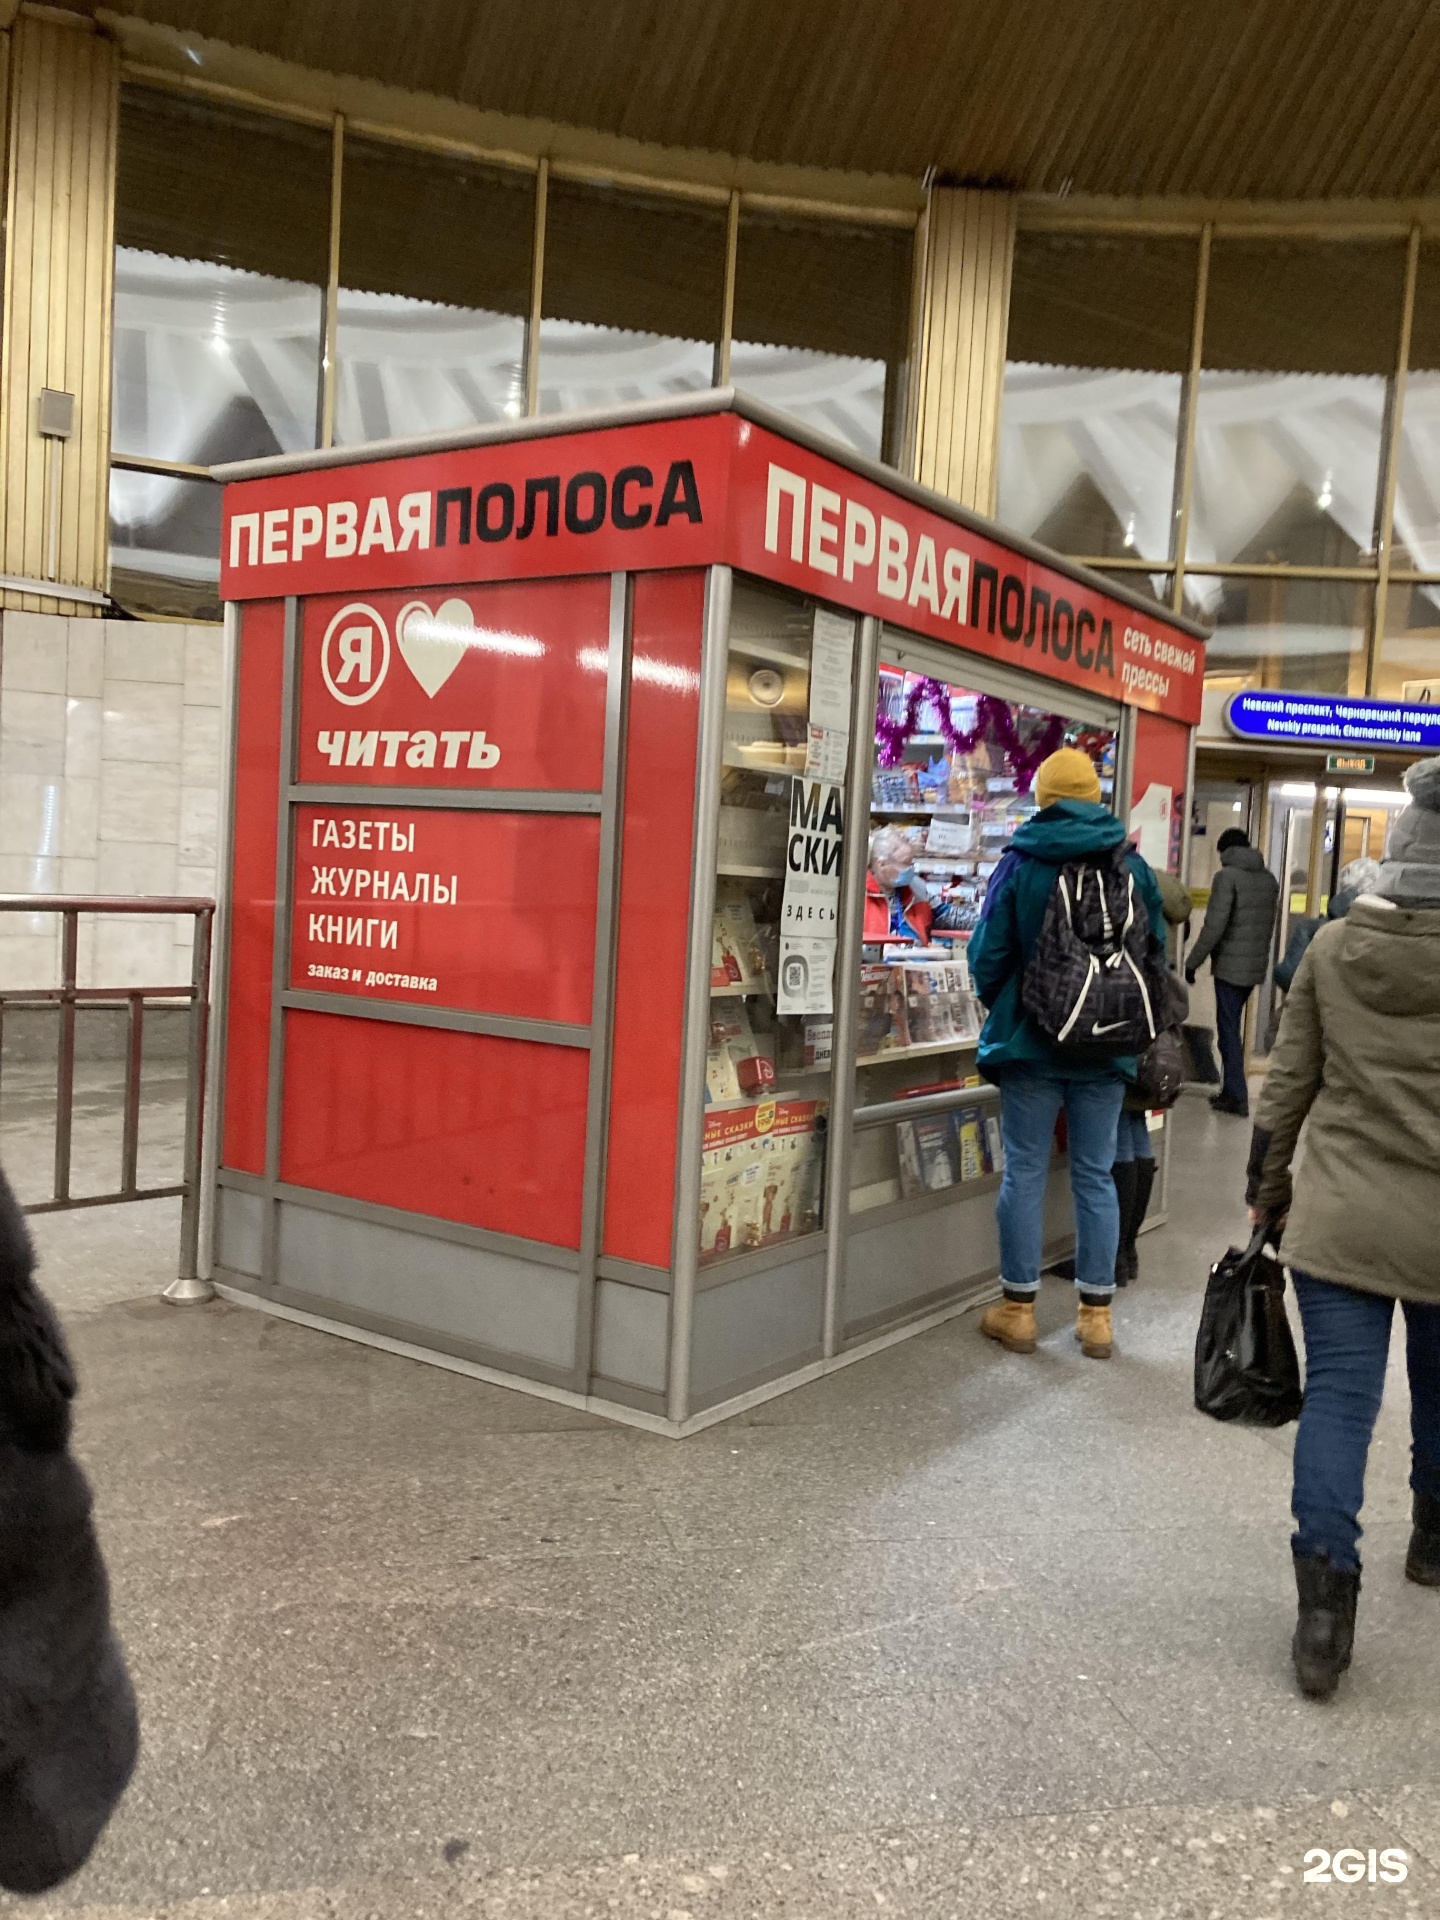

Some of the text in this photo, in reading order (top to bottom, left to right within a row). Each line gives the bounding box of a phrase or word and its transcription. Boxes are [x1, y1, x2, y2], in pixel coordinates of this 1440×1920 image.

[336, 626, 373, 684] Я
[1123, 626, 1196, 676] сеть свежей
[1121, 661, 1170, 698] прессы
[1242, 697, 1284, 713] Невский
[1285, 702, 1333, 718] проспект,
[1335, 704, 1402, 722] Чернорецкий
[316, 729, 501, 769] читать
[1267, 718, 1301, 735] Nevskiy
[1343, 724, 1402, 743] Chernoretskiy
[1402, 728, 1422, 743] lane
[791, 777, 843, 836] МА
[312, 818, 415, 853] ГАЗЕТЫ
[788, 833, 843, 878] СКИ
[310, 865, 458, 906] ЖУРНАЛЫ
[308, 913, 398, 950] КНИГИ
[307, 963, 438, 992] заказ и доставка
